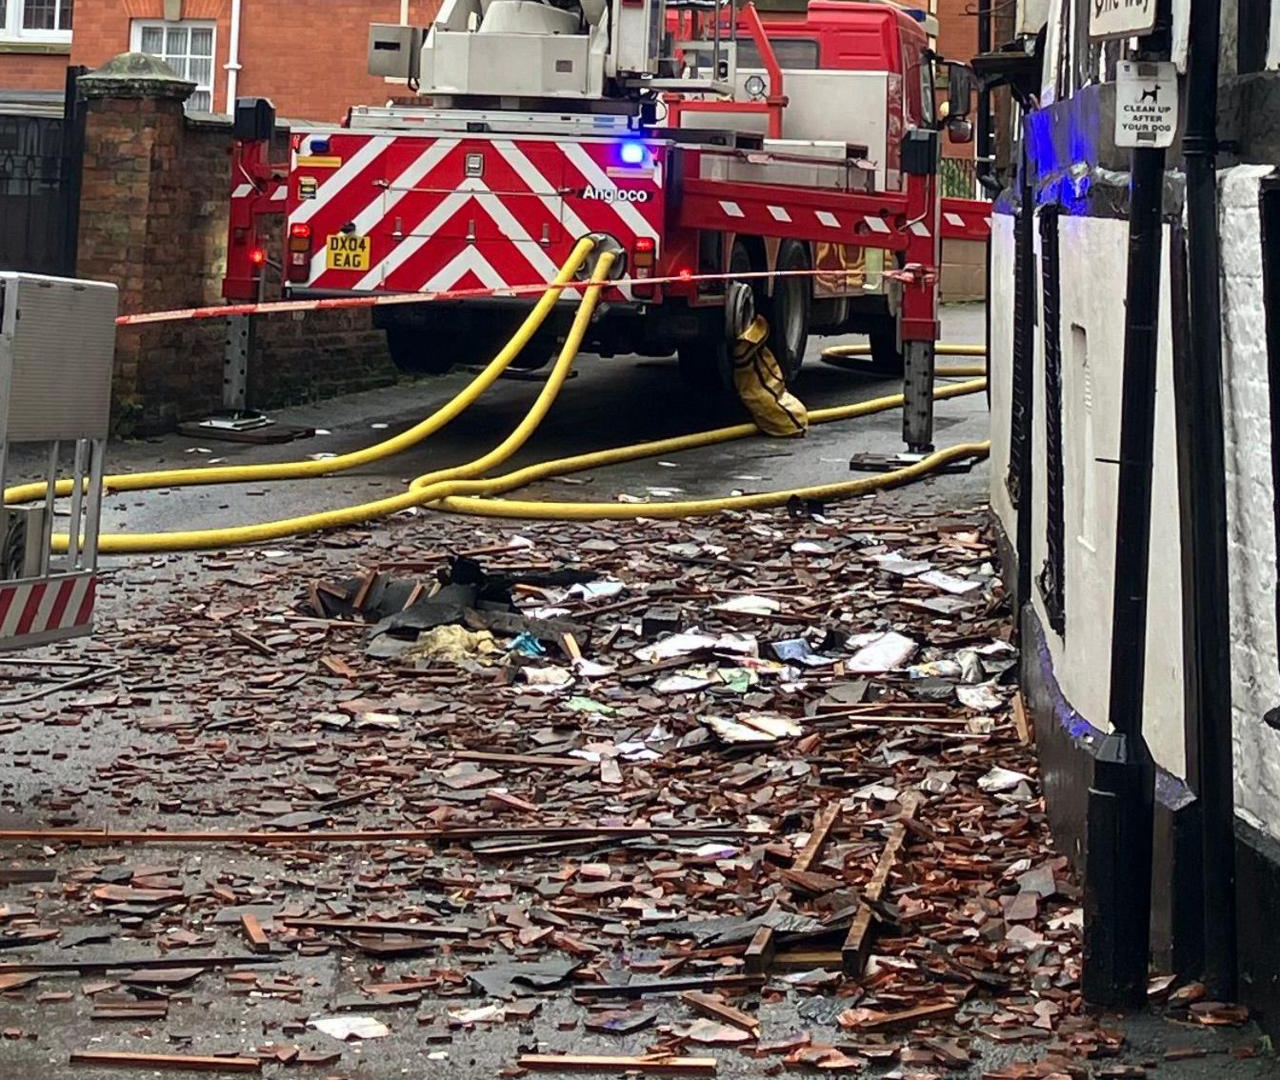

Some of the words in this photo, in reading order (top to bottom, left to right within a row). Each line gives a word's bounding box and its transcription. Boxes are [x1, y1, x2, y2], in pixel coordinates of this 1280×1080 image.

[1123, 104, 1156, 113] CLEAN
[1133, 114, 1163, 122] AFTER
[1122, 123, 1149, 131] YOUR
[1152, 124, 1172, 132] DOG
[582, 183, 648, 204] Angloco
[330, 237, 367, 253] DX04
[333, 253, 362, 268] EAG
